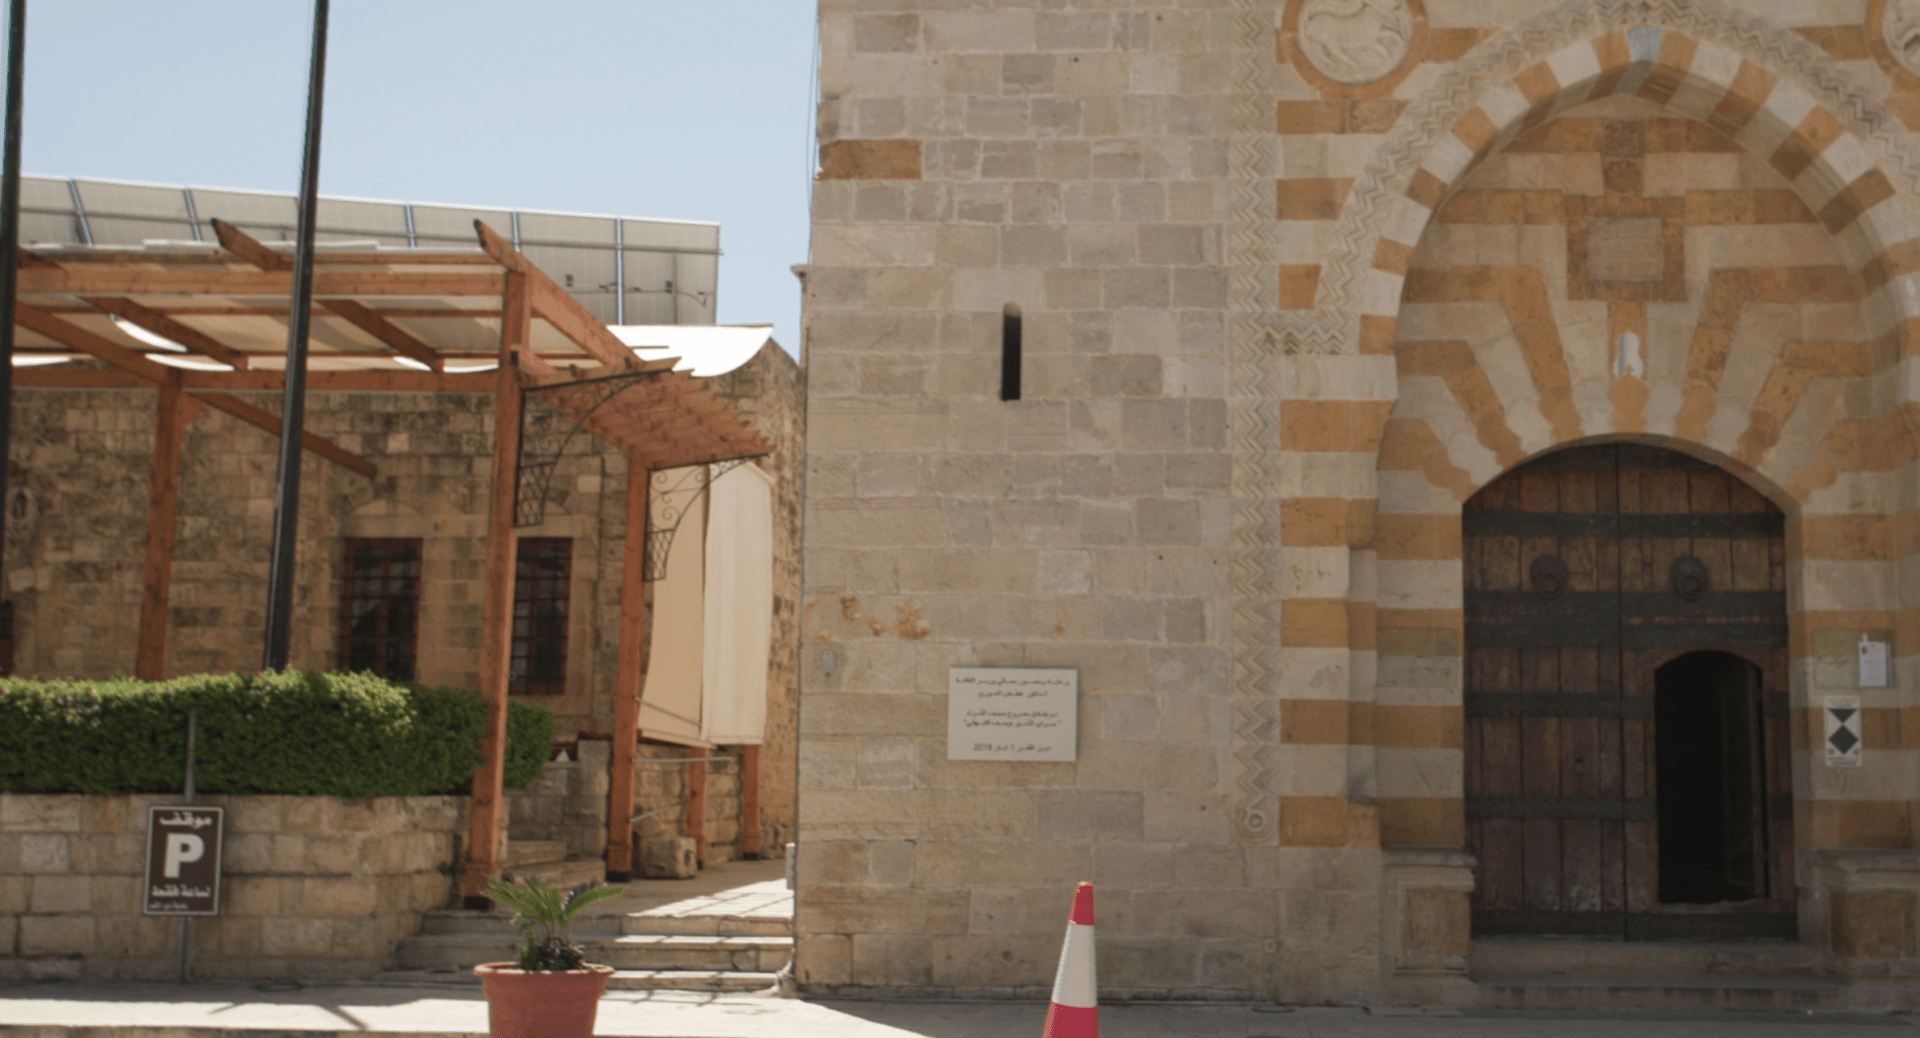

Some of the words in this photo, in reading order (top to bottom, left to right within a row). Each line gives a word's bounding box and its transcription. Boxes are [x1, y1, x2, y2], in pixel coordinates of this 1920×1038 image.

[973, 743, 992, 752] 2018
[160, 811, 212, 829] موقف
[164, 832, 205, 878] P
[151, 883, 180, 897] فقط
[180, 883, 211, 898] لساعة
